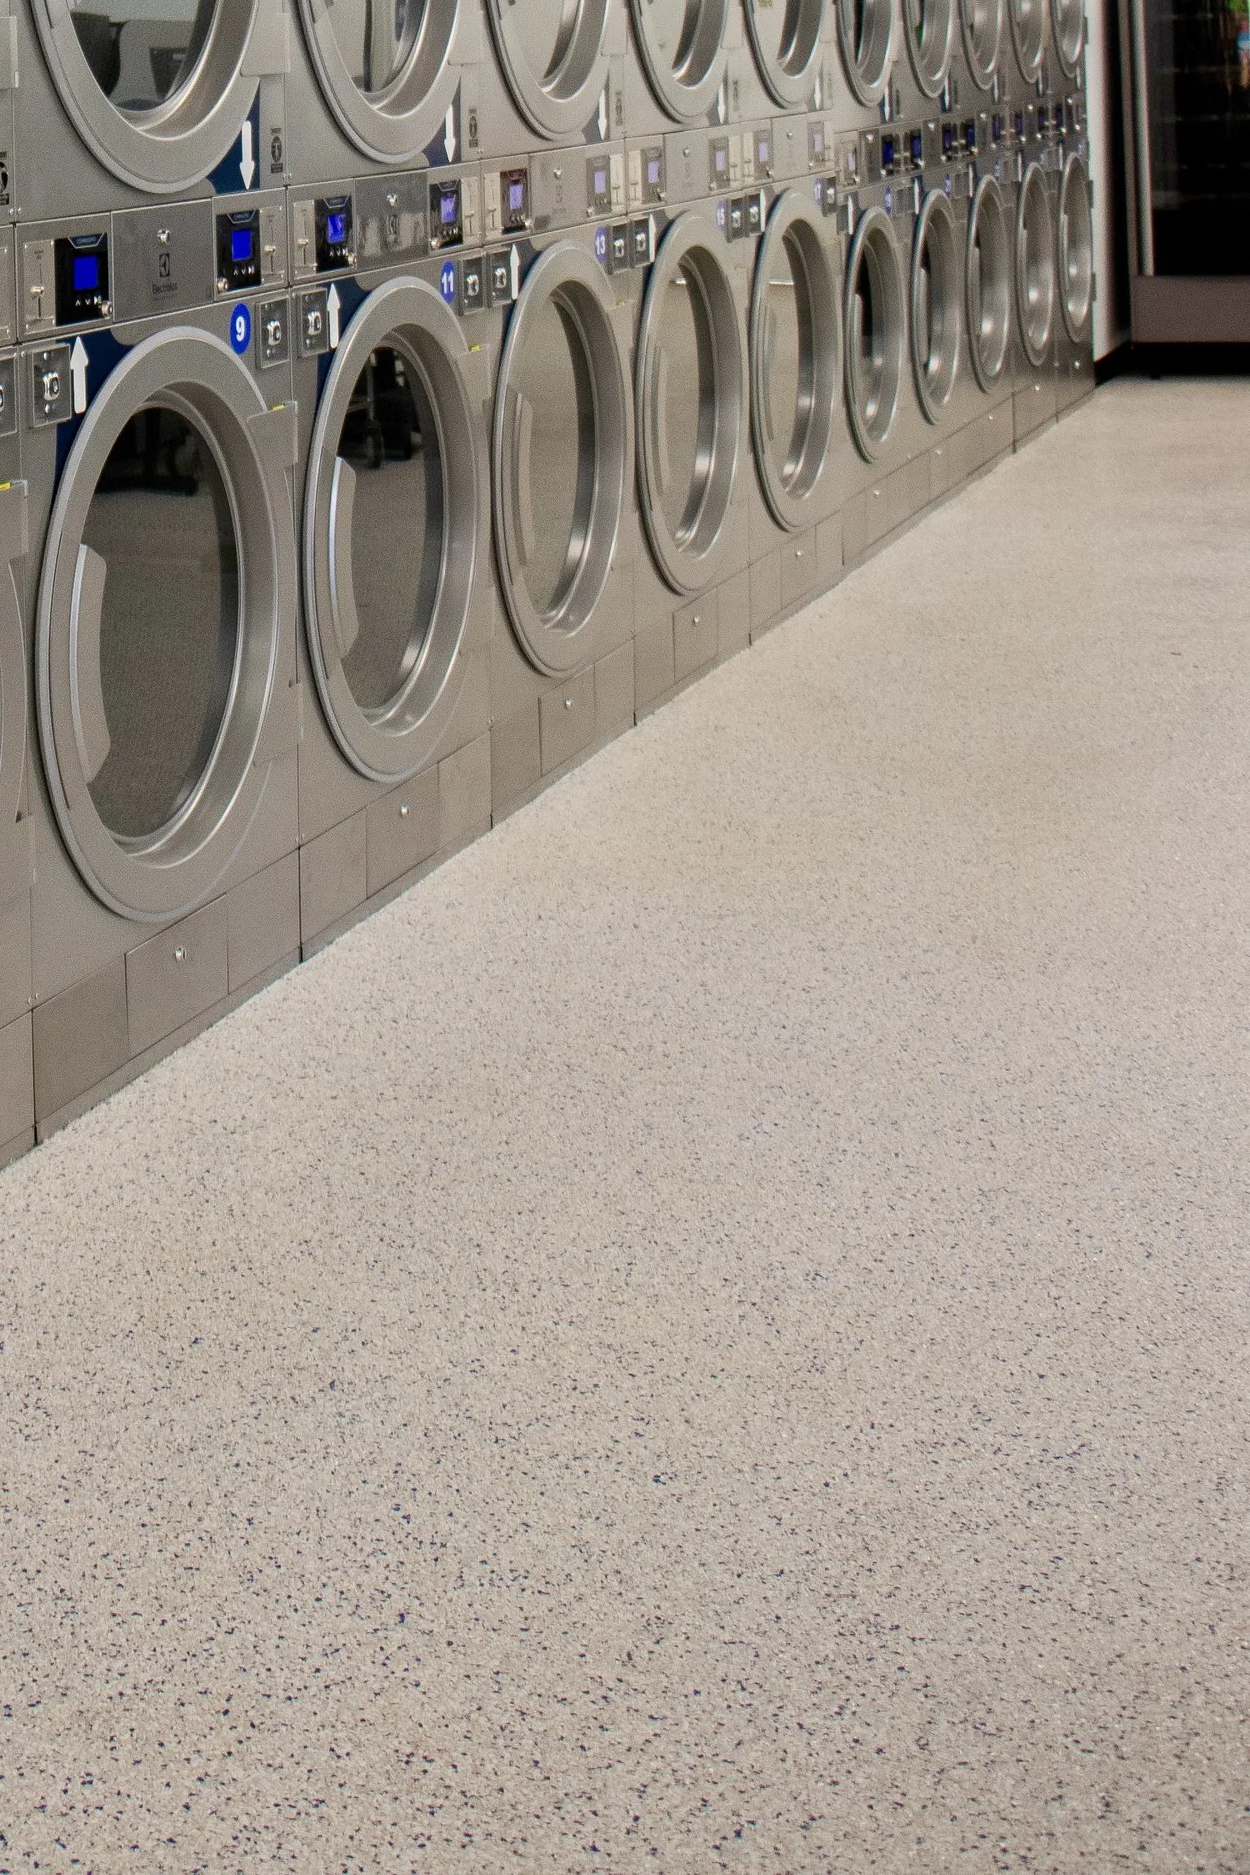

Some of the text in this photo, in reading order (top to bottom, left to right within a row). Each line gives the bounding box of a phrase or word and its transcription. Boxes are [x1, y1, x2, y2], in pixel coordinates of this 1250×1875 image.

[596, 235, 606, 256] 13
[441, 271, 454, 294] 11
[236, 316, 245, 341] 9
